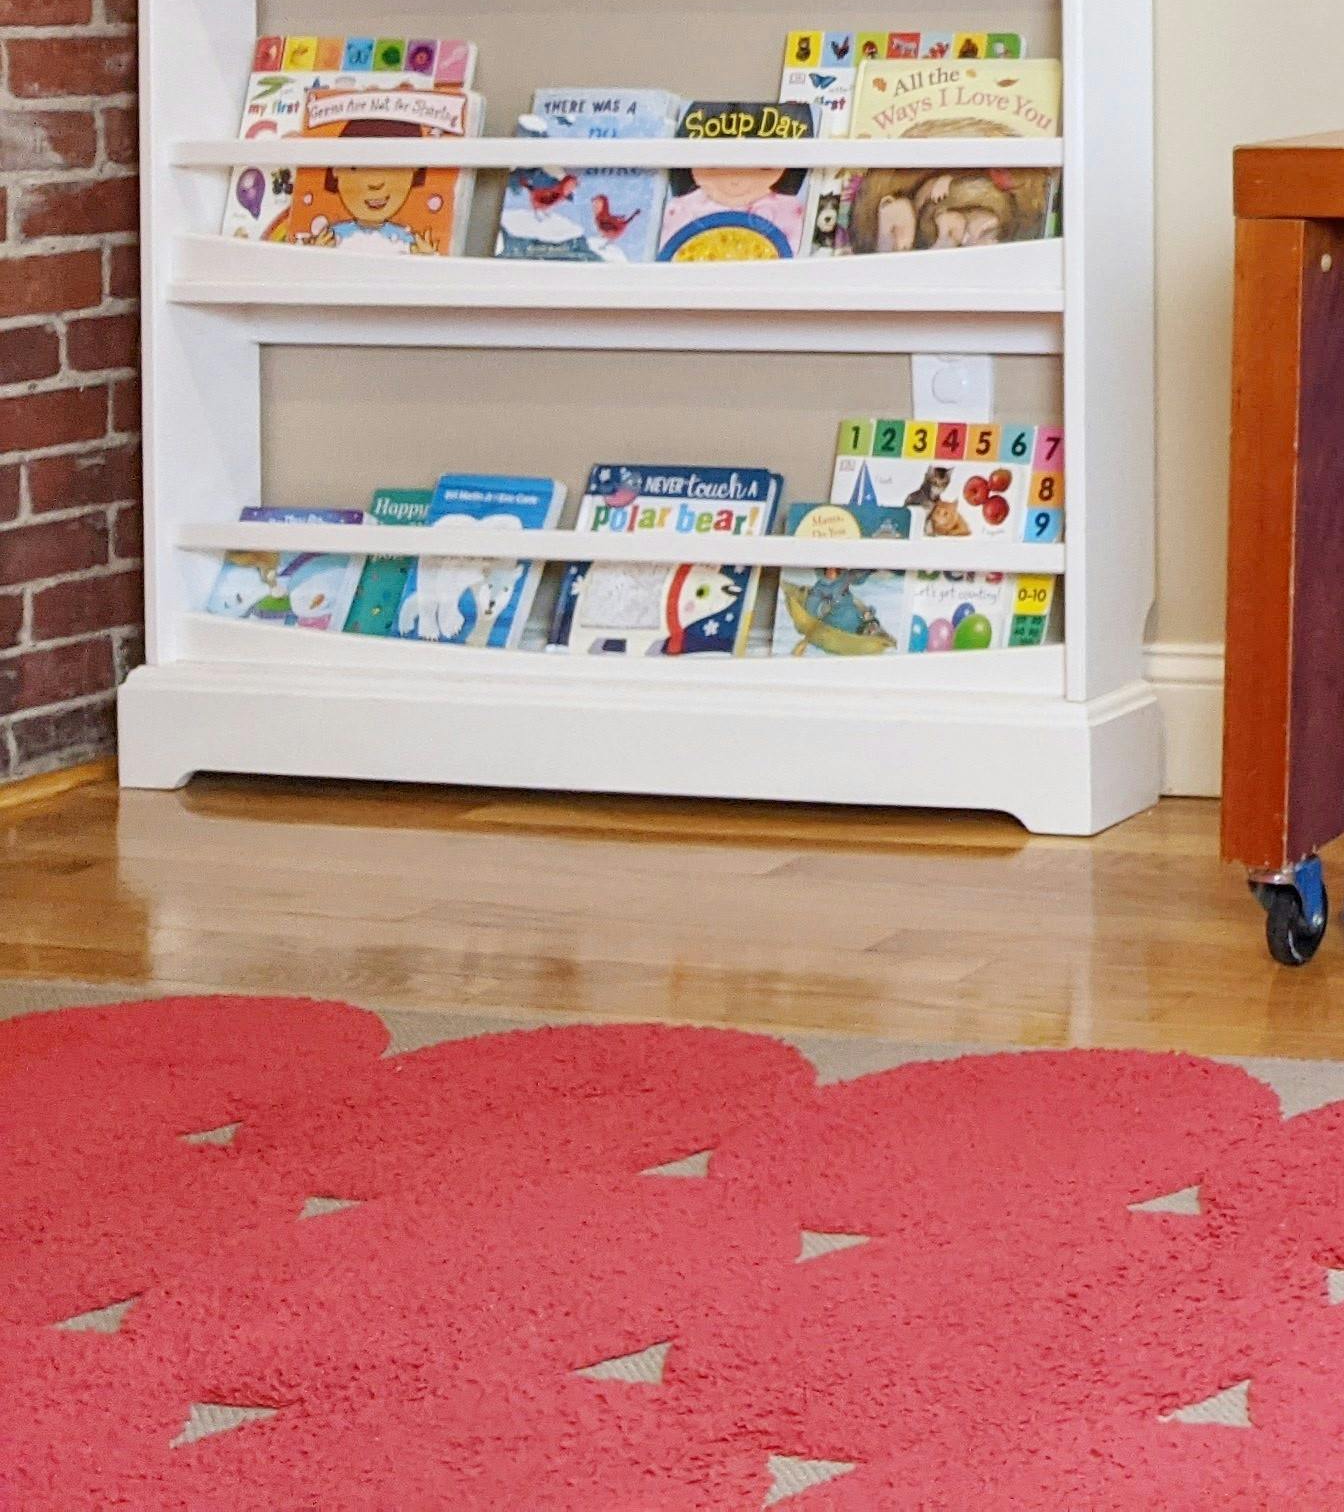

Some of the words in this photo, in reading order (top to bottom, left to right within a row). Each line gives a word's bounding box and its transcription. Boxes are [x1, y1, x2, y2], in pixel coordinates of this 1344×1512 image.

[893, 71, 925, 97] All
[928, 67, 960, 86] the
[370, 96, 390, 112] Not
[544, 101, 587, 115] THERE
[592, 99, 621, 114] WAS
[627, 101, 638, 116] A
[871, 94, 932, 130] Ways
[938, 88, 950, 107] I
[954, 87, 1009, 111] Love
[1012, 95, 1052, 130] You
[685, 108, 755, 138] Soup
[757, 106, 808, 138] Day
[850, 425, 861, 450] 1
[881, 427, 897, 453] 2
[913, 428, 928, 453] 3
[943, 428, 960, 453] 4
[975, 430, 992, 456] 5
[1011, 431, 1028, 458] 6
[1045, 436, 1060, 461] 7
[644, 475, 685, 494] NEVER
[687, 472, 745, 499] touch
[747, 480, 759, 498] A
[1037, 476, 1055, 502] 8
[375, 497, 432, 521] Happy
[588, 504, 671, 532] polar
[675, 502, 759, 536] bear!
[1034, 511, 1050, 537] 9
[1018, 588, 1048, 603] 0-10
